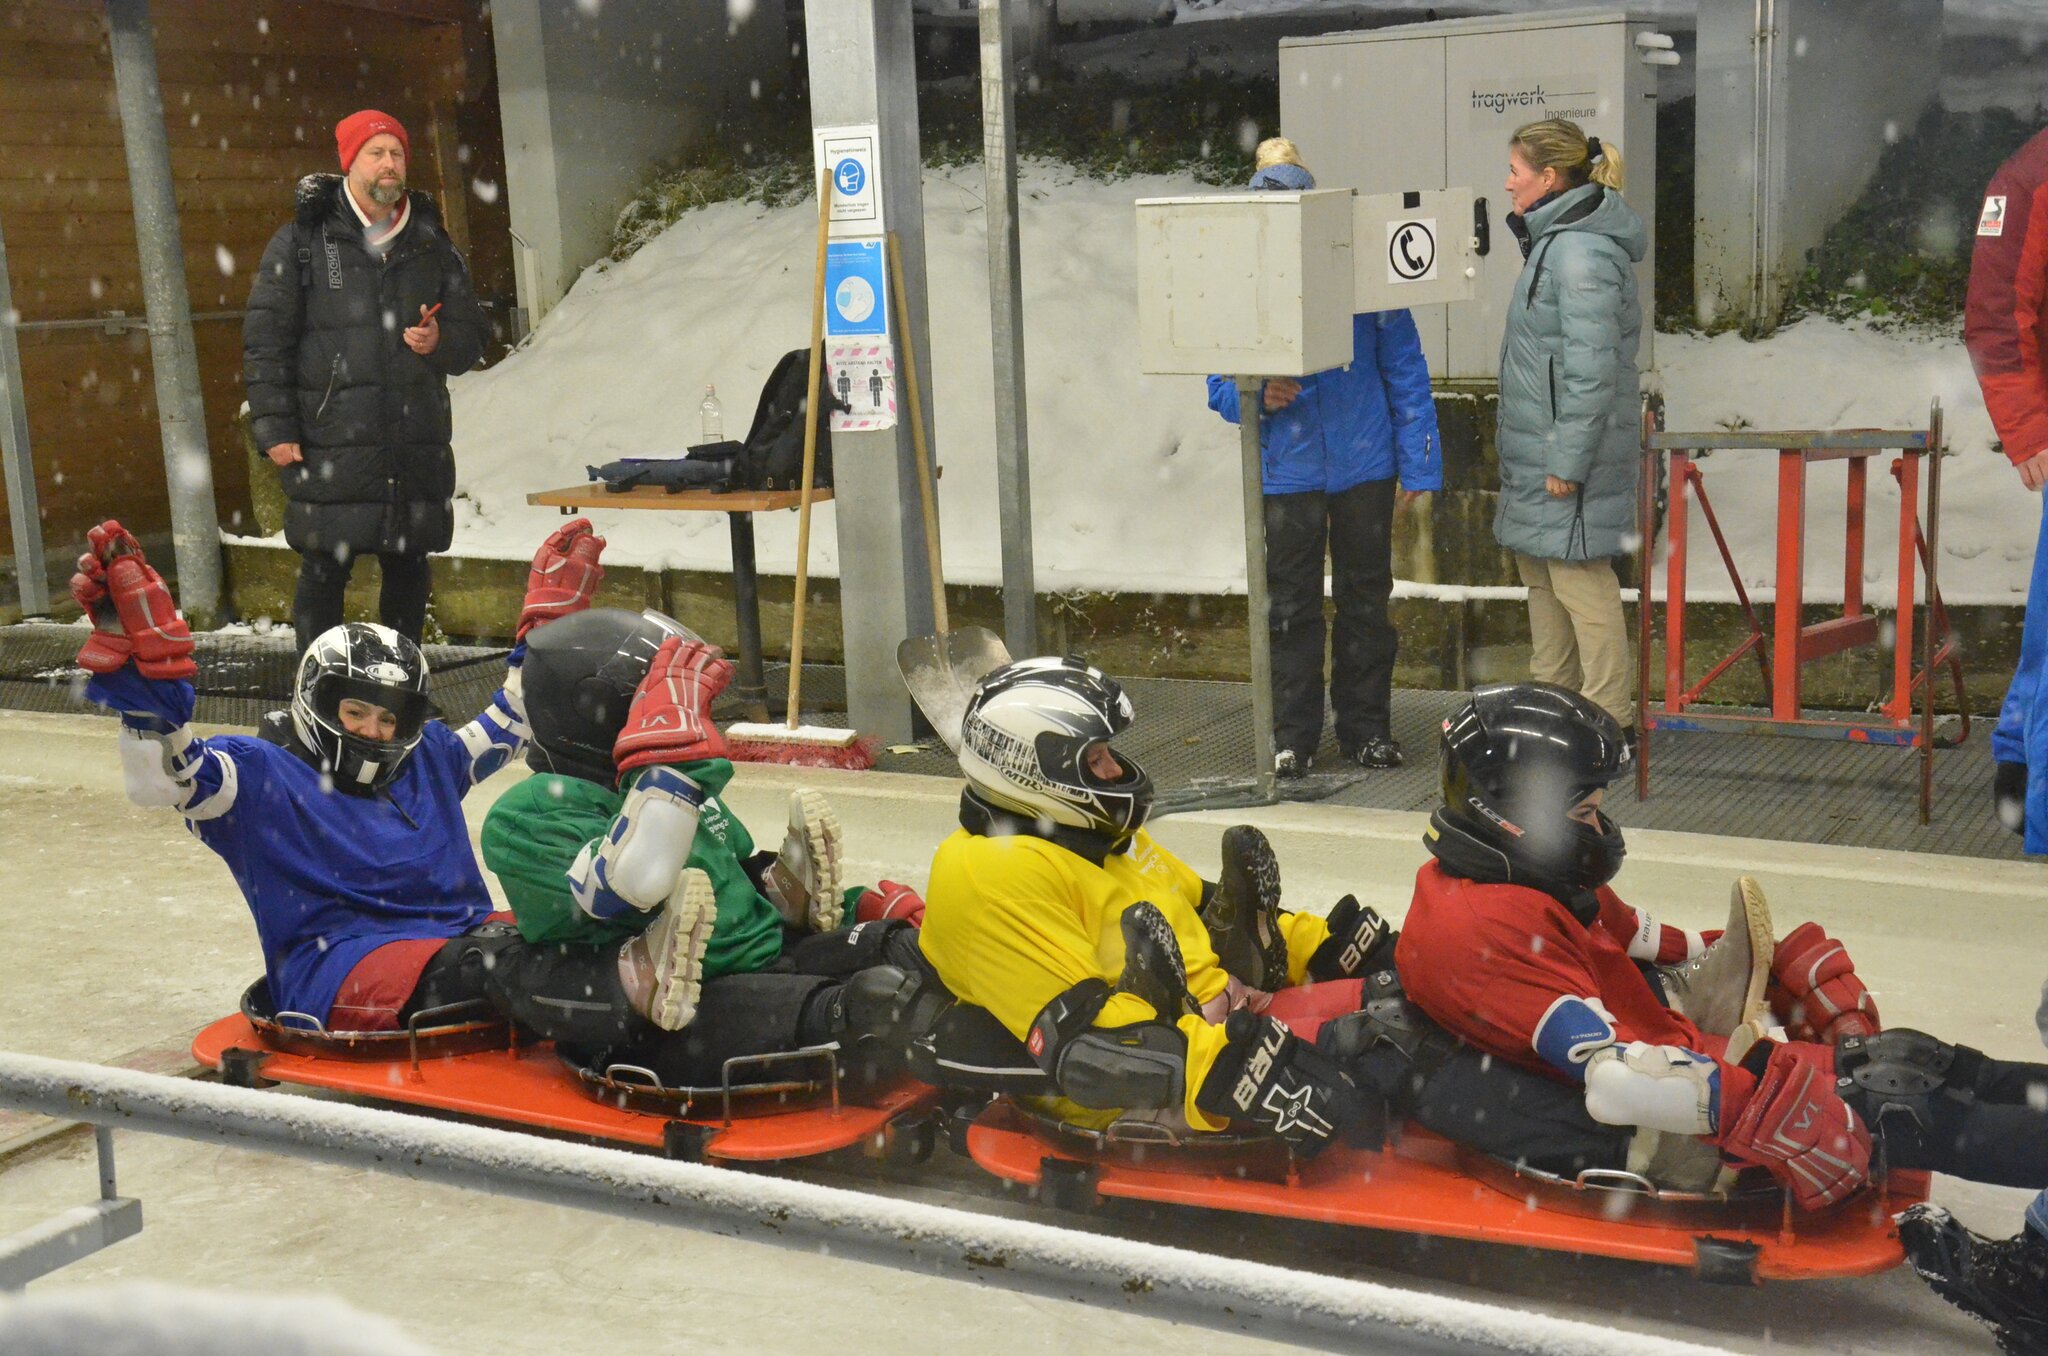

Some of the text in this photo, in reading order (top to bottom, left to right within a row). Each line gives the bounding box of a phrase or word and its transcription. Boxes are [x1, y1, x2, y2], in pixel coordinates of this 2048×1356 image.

[1472, 85, 1546, 113] tragwerk
[1544, 108, 1596, 119] Ingenieure
[1339, 913, 1383, 975] BAU
